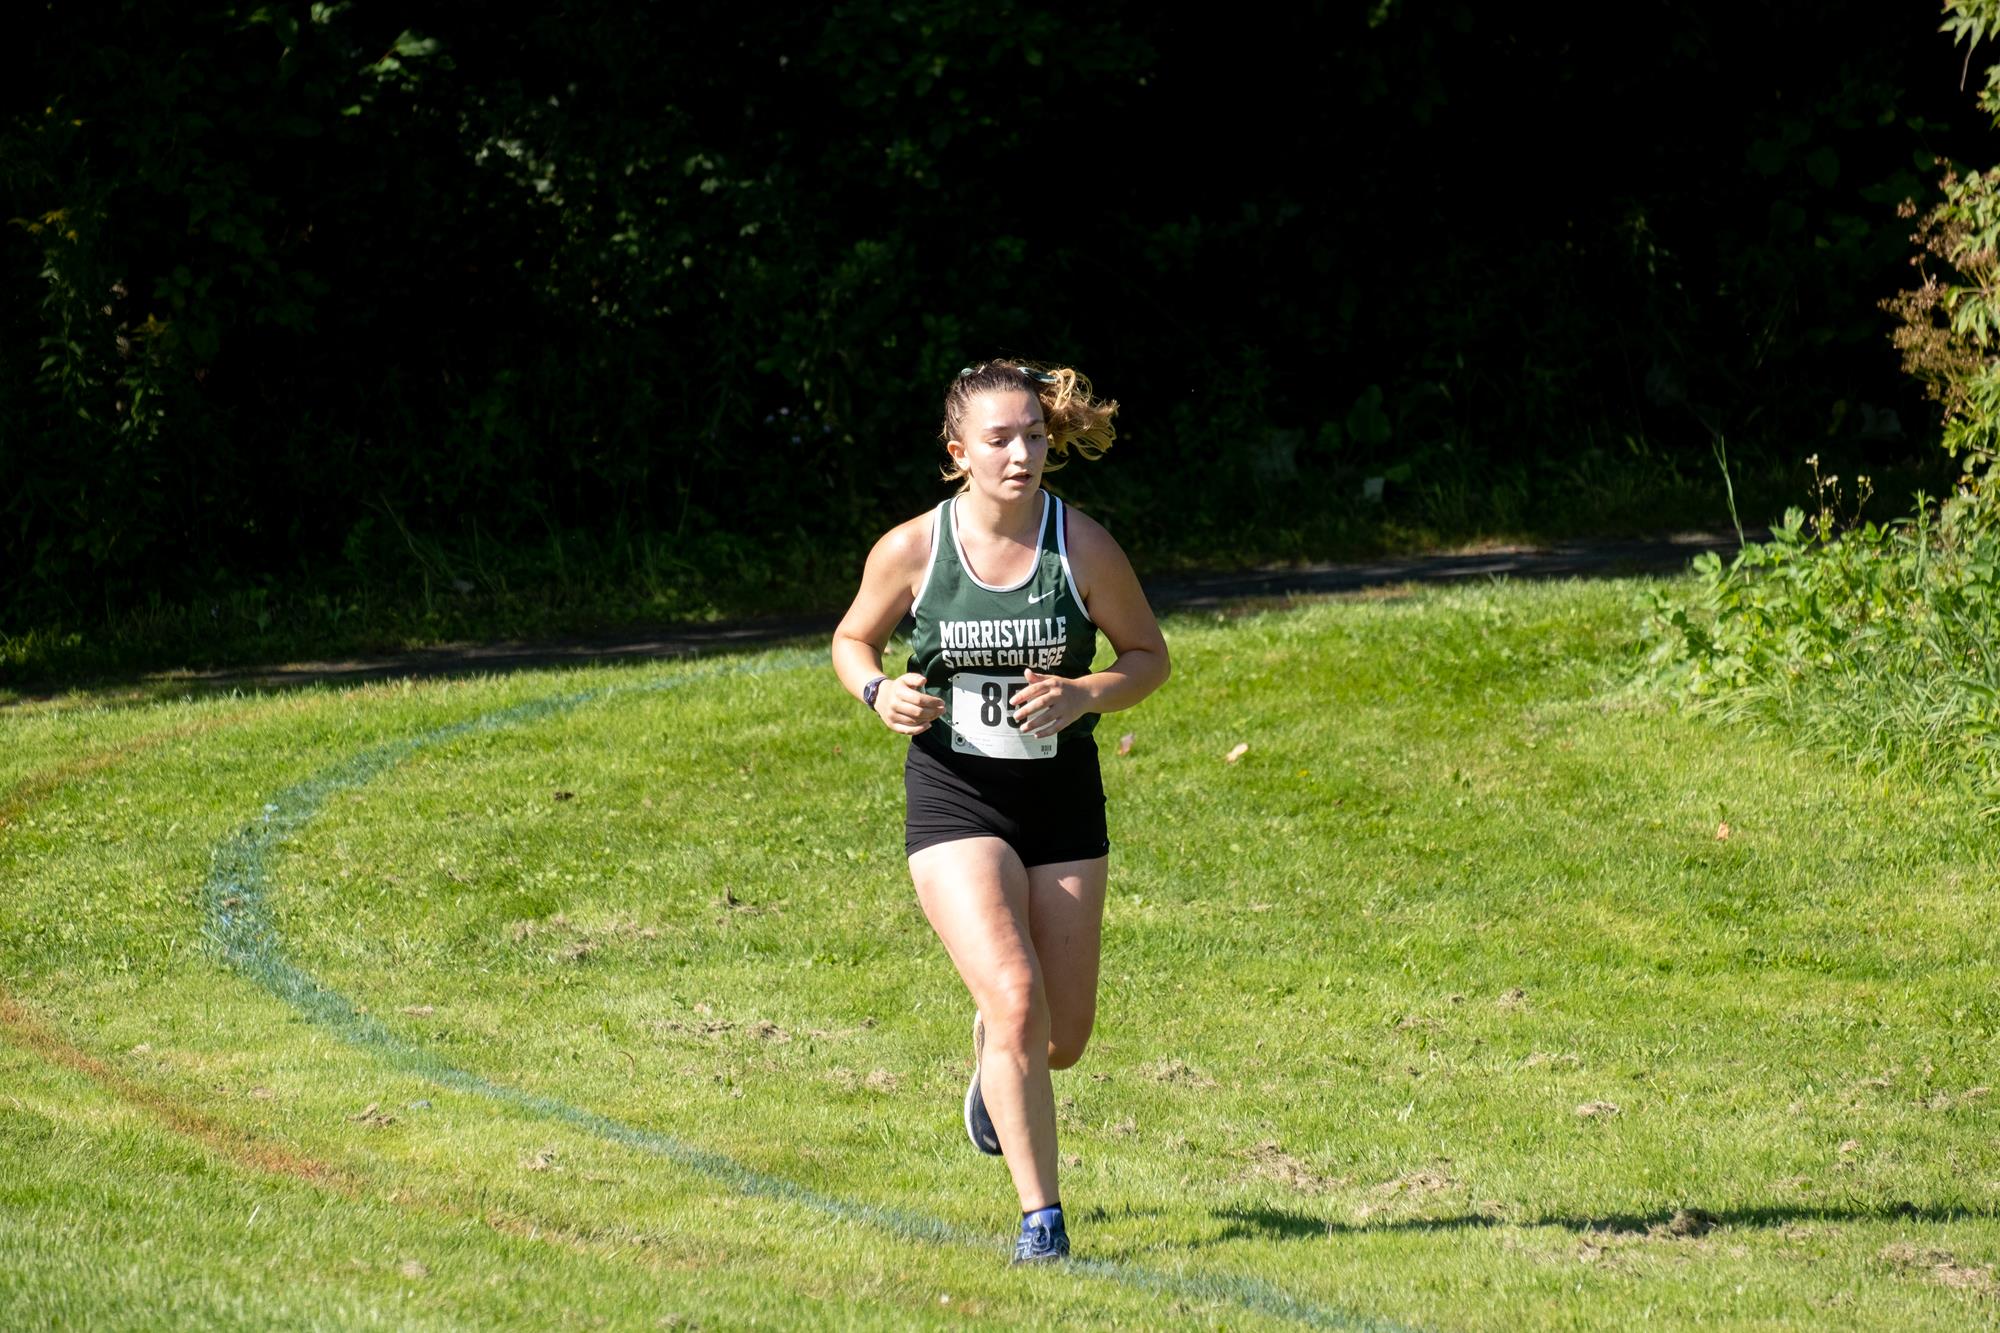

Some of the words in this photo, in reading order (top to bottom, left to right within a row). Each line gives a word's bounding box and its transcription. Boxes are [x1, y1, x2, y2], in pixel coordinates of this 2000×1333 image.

[940, 616, 1067, 649] MORRISVILLE
[941, 649, 994, 669] STATE
[997, 646, 1067, 670] COLLEGE
